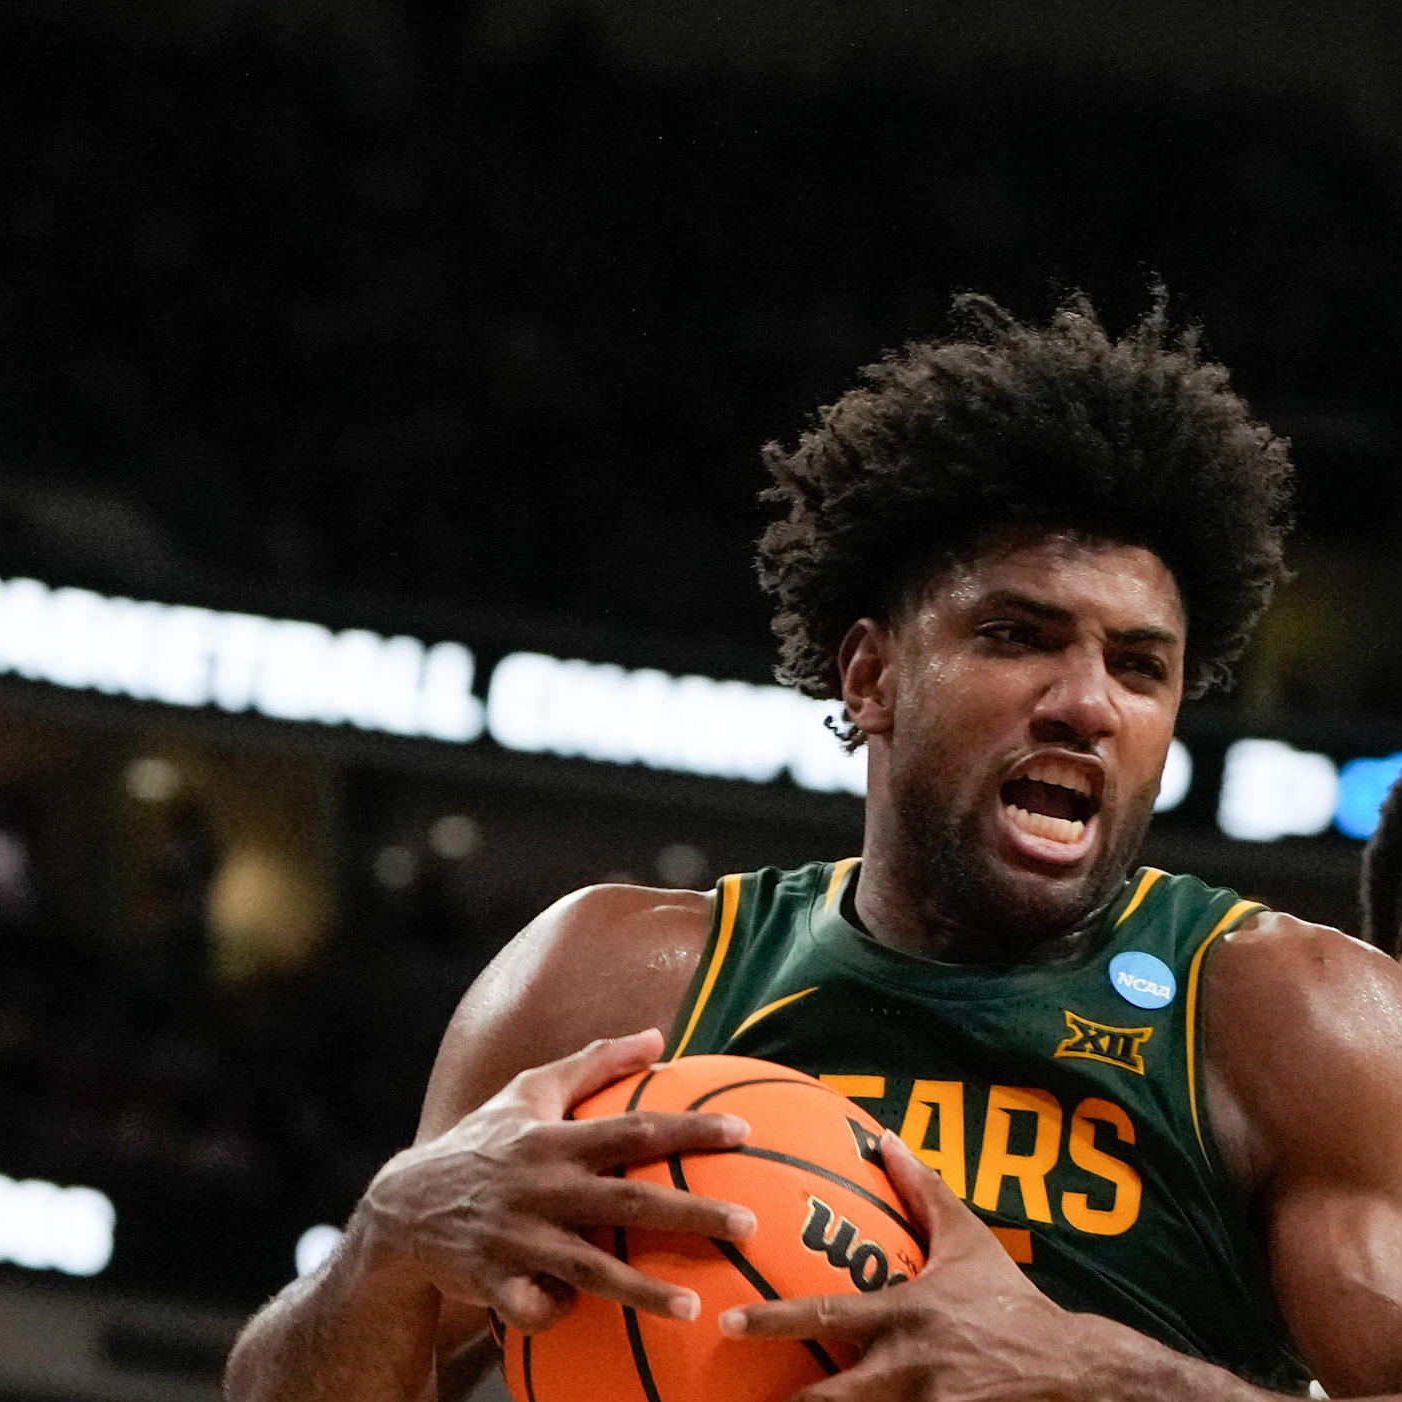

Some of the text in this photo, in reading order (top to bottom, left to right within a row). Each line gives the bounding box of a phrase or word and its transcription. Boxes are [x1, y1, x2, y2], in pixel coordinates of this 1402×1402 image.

[1117, 971, 1172, 1000] NCAA
[1058, 1013, 1150, 1073] XII
[818, 1073, 1142, 1236] ARS
